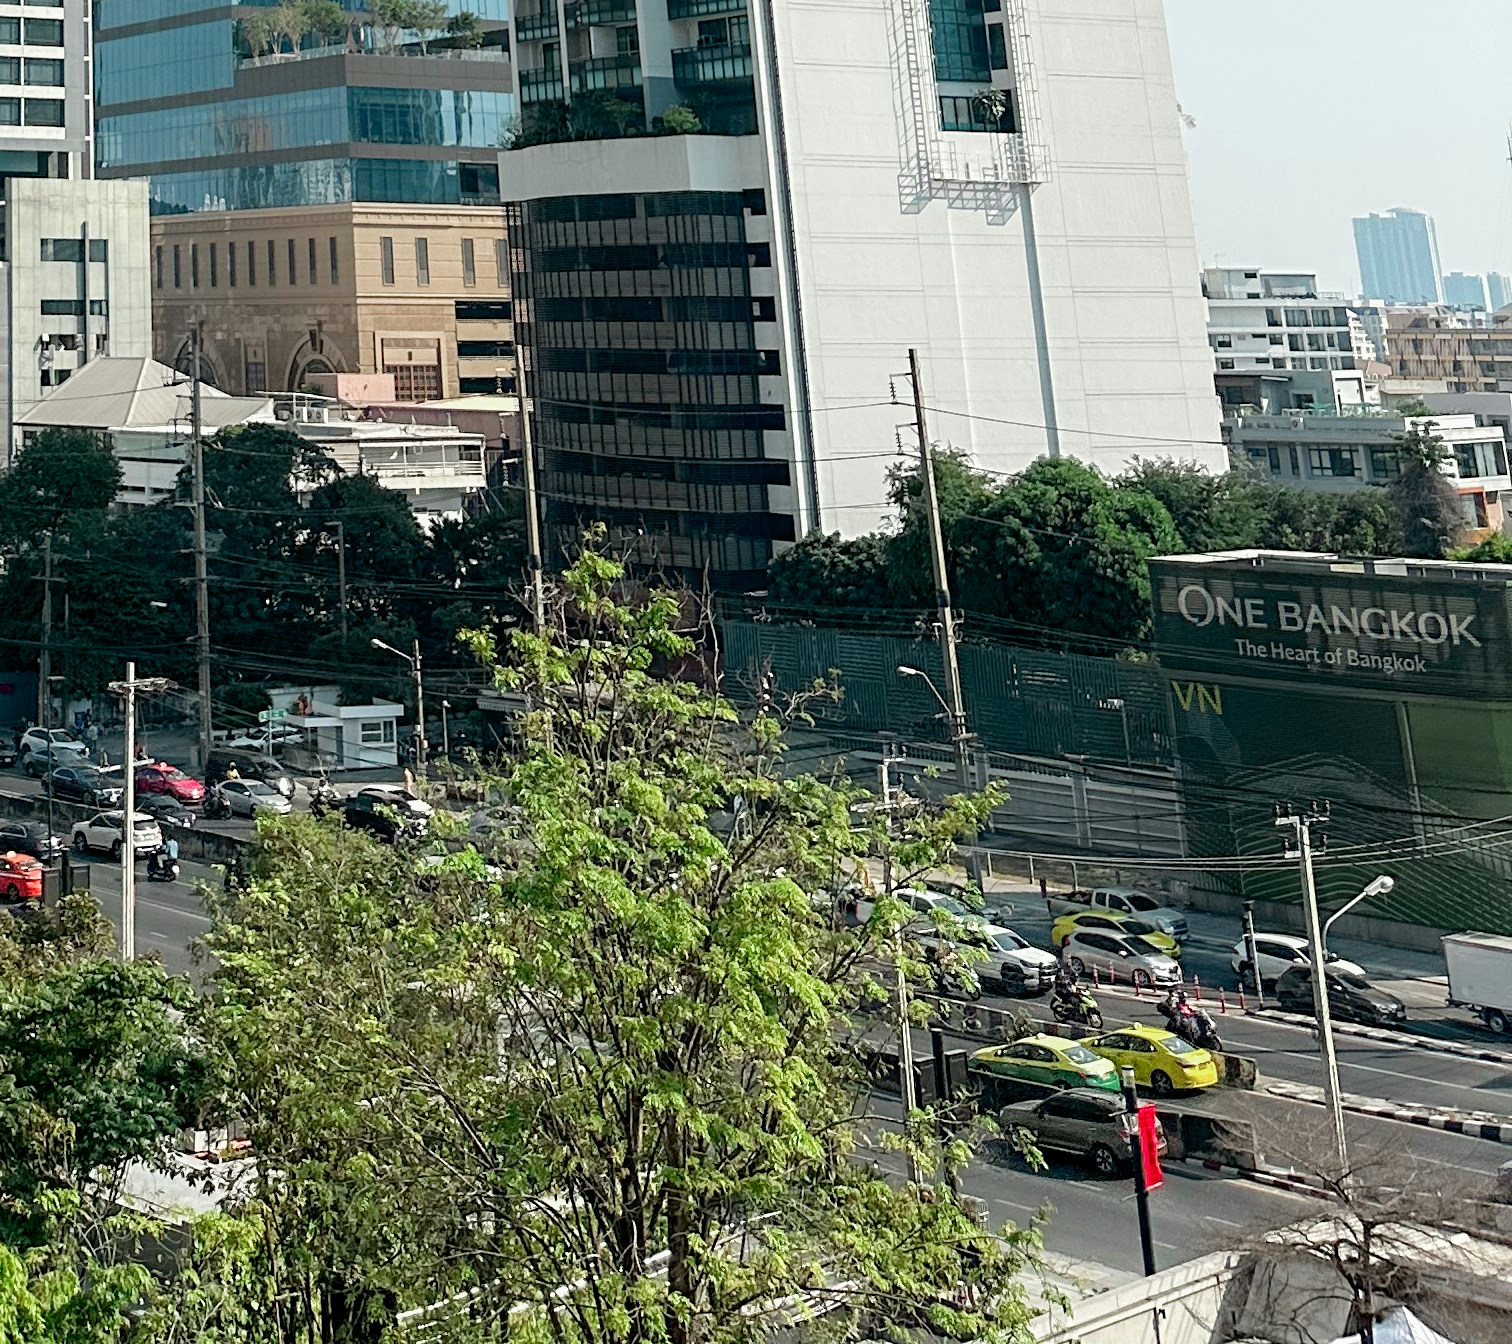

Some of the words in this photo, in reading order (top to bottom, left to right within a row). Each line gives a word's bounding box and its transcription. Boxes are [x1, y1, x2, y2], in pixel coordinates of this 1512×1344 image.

[1177, 585, 1269, 629] ONE
[1277, 600, 1481, 648] BANGKOK
[1235, 638, 1268, 658] The
[1271, 641, 1320, 664] Heart
[1324, 647, 1343, 665] of
[1347, 648, 1427, 675] Bangkok
